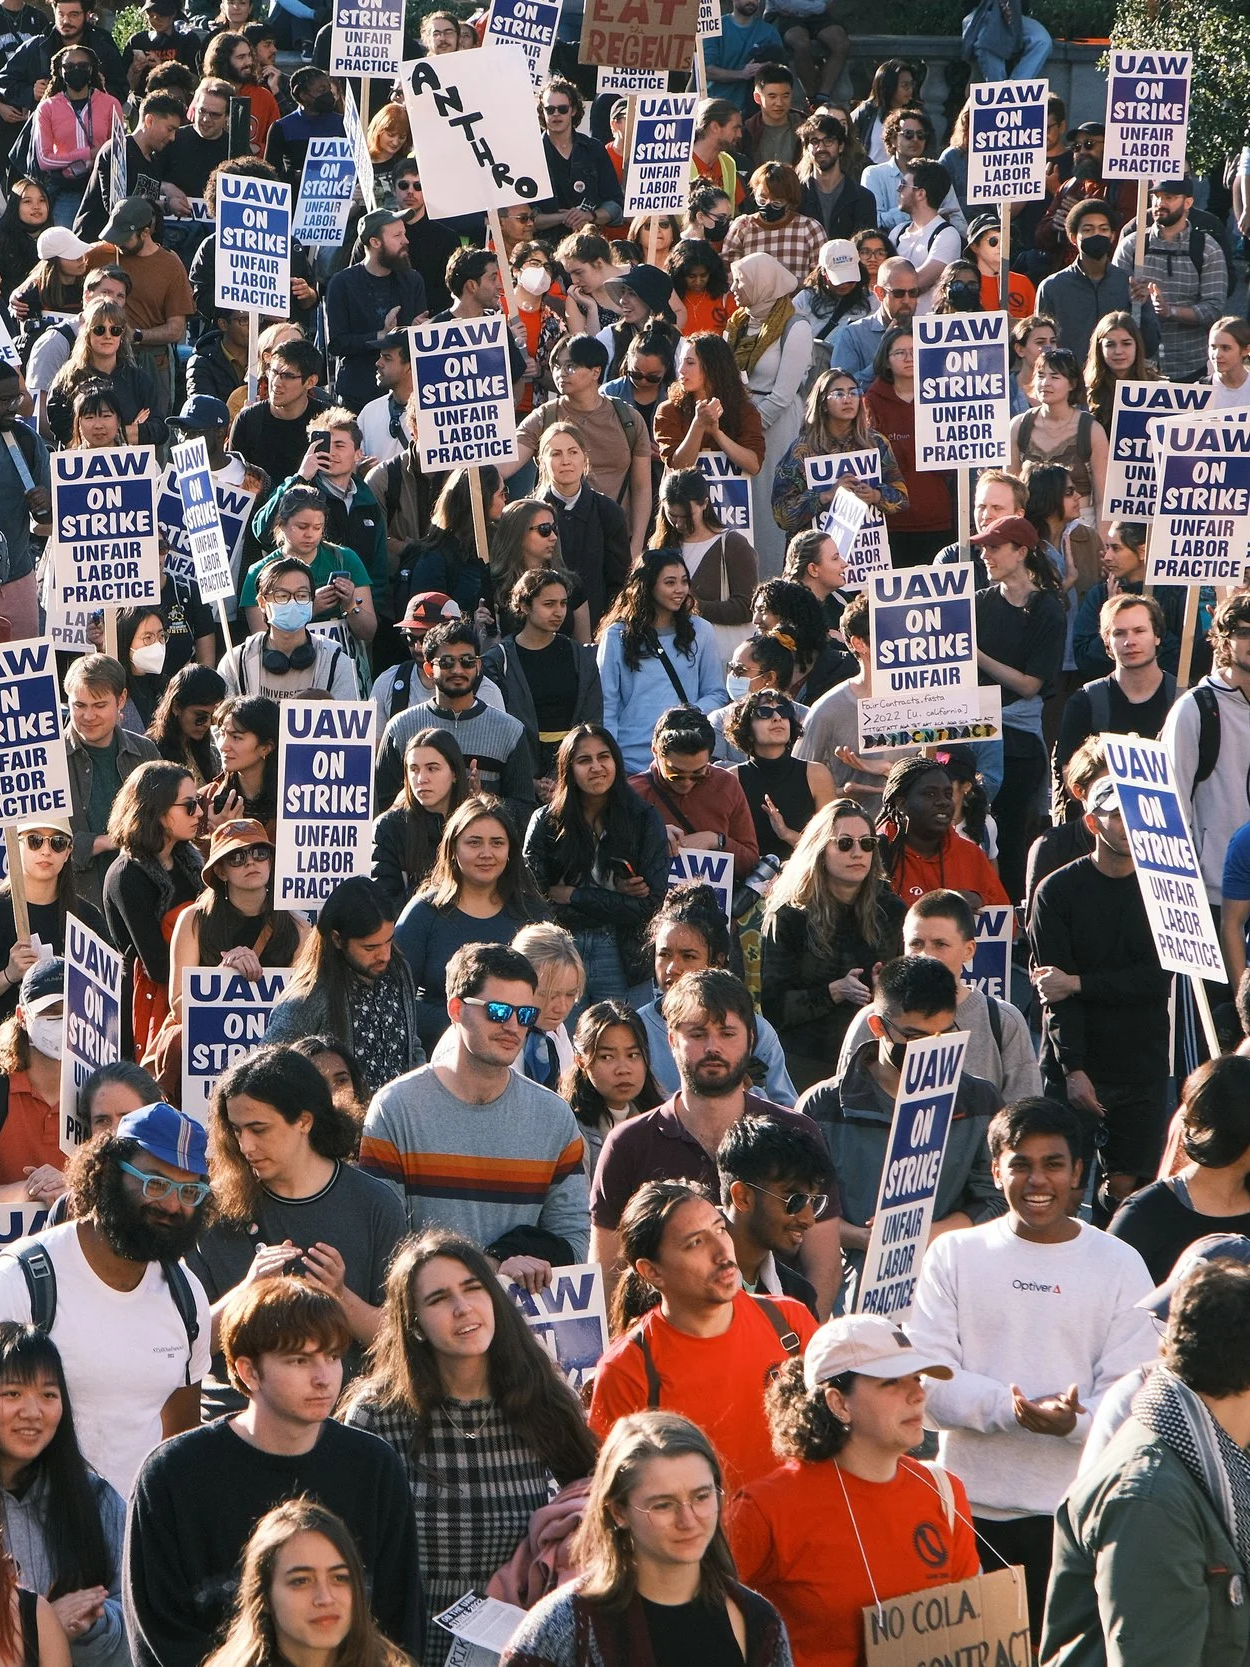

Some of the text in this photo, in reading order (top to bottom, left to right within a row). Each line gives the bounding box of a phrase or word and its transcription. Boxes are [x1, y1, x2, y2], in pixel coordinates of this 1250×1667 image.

[592, 0, 686, 26] EAT
[1115, 55, 1189, 75] UAW
[975, 84, 1045, 106] UAW
[1135, 81, 1163, 100] ON
[995, 109, 1022, 128] ON
[1113, 101, 1183, 121] STRIKE
[411, 62, 538, 198] ANTHRO
[975, 128, 1041, 149] STRIKE
[1120, 126, 1174, 141] UNFAIR
[982, 152, 1033, 168] UNFAIR
[1121, 142, 1170, 157] LABOR
[984, 167, 1031, 182] LABOR
[1108, 158, 1180, 173] PRACTICE
[222, 177, 288, 207] UAW
[973, 181, 1041, 198] PRACTICE
[242, 208, 267, 229] ON
[222, 226, 286, 254] STRIKE
[230, 253, 279, 274] UNFAIR
[232, 270, 277, 291] LABOR
[221, 285, 287, 309] PRACTICE
[414, 321, 501, 352] UAW
[919, 317, 1003, 344] UAW
[444, 354, 478, 377] ON
[946, 349, 977, 373] ON
[422, 375, 505, 404] STRIKE
[922, 373, 1003, 399] STRIKE
[433, 404, 498, 427] UNFAIR
[932, 404, 994, 423] UNFAIR
[438, 423, 497, 445] LABOR
[936, 423, 992, 442] LABOR
[1170, 427, 1250, 452] UAW
[426, 439, 513, 465] PRACTICE
[923, 441, 1006, 463] PRACTICE
[57, 451, 150, 481] UAW
[1192, 461, 1226, 484] ON
[87, 485, 122, 510] ON
[1163, 487, 1248, 511] STRIKE
[61, 510, 150, 537] STRIKE
[1170, 519, 1235, 537] UNFAIR
[72, 541, 141, 563] UNFAIR
[1170, 539, 1229, 557] LABOR
[77, 562, 139, 582] LABOR
[1154, 559, 1240, 577] PRACTICE
[63, 580, 155, 603] PRACTICE
[875, 569, 969, 602] UAW
[905, 606, 941, 633] ON
[879, 633, 969, 664] STRIKE
[891, 667, 960, 691] UNFAIR
[287, 707, 372, 739] UAW
[312, 750, 344, 780] ON
[1106, 743, 1169, 785] UAW
[286, 783, 367, 813] STRIKE
[1138, 793, 1166, 828] ON
[295, 825, 358, 847] UNFAIR
[1132, 829, 1194, 870] STRIKE
[297, 851, 354, 873] LABOR
[1148, 875, 1198, 908] UNFAIR
[1158, 905, 1204, 937] LABOR
[1157, 933, 1221, 969] PRACTICE
[905, 1044, 964, 1094] UAW
[911, 1105, 936, 1148] ON
[886, 1151, 941, 1200] STRIKE
[883, 1207, 923, 1244] UNFAIR
[876, 1244, 915, 1281] LABOR
[862, 1278, 917, 1313] PRACTICE
[1012, 1279, 1053, 1294] Optiver
[871, 1606, 905, 1645] NO
